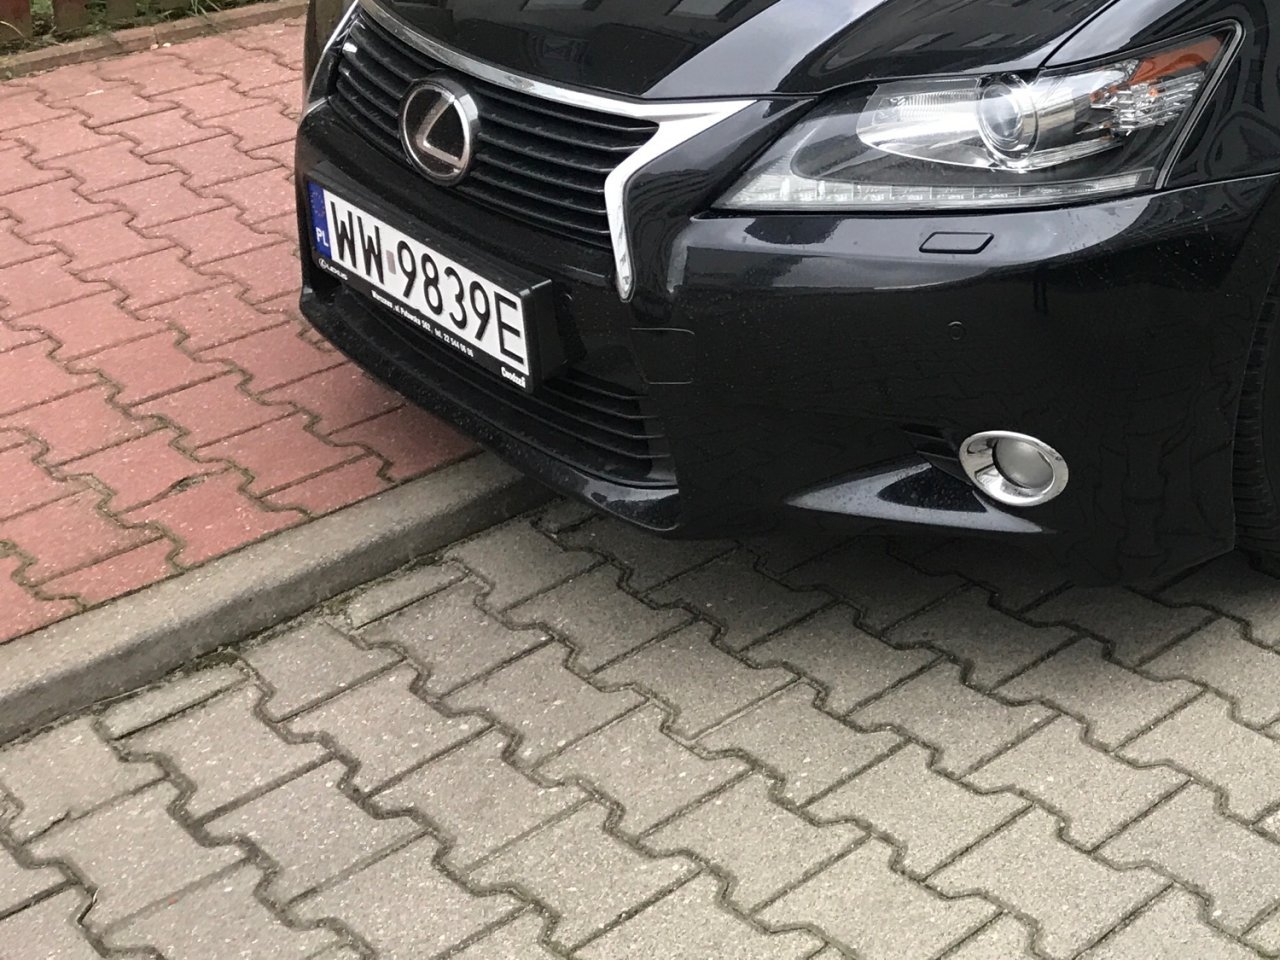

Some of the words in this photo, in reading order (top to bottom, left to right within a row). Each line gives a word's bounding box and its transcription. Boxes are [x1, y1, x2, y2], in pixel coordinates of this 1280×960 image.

[315, 227, 329, 248] PL
[330, 201, 385, 285] WW
[396, 240, 525, 366] 9839E
